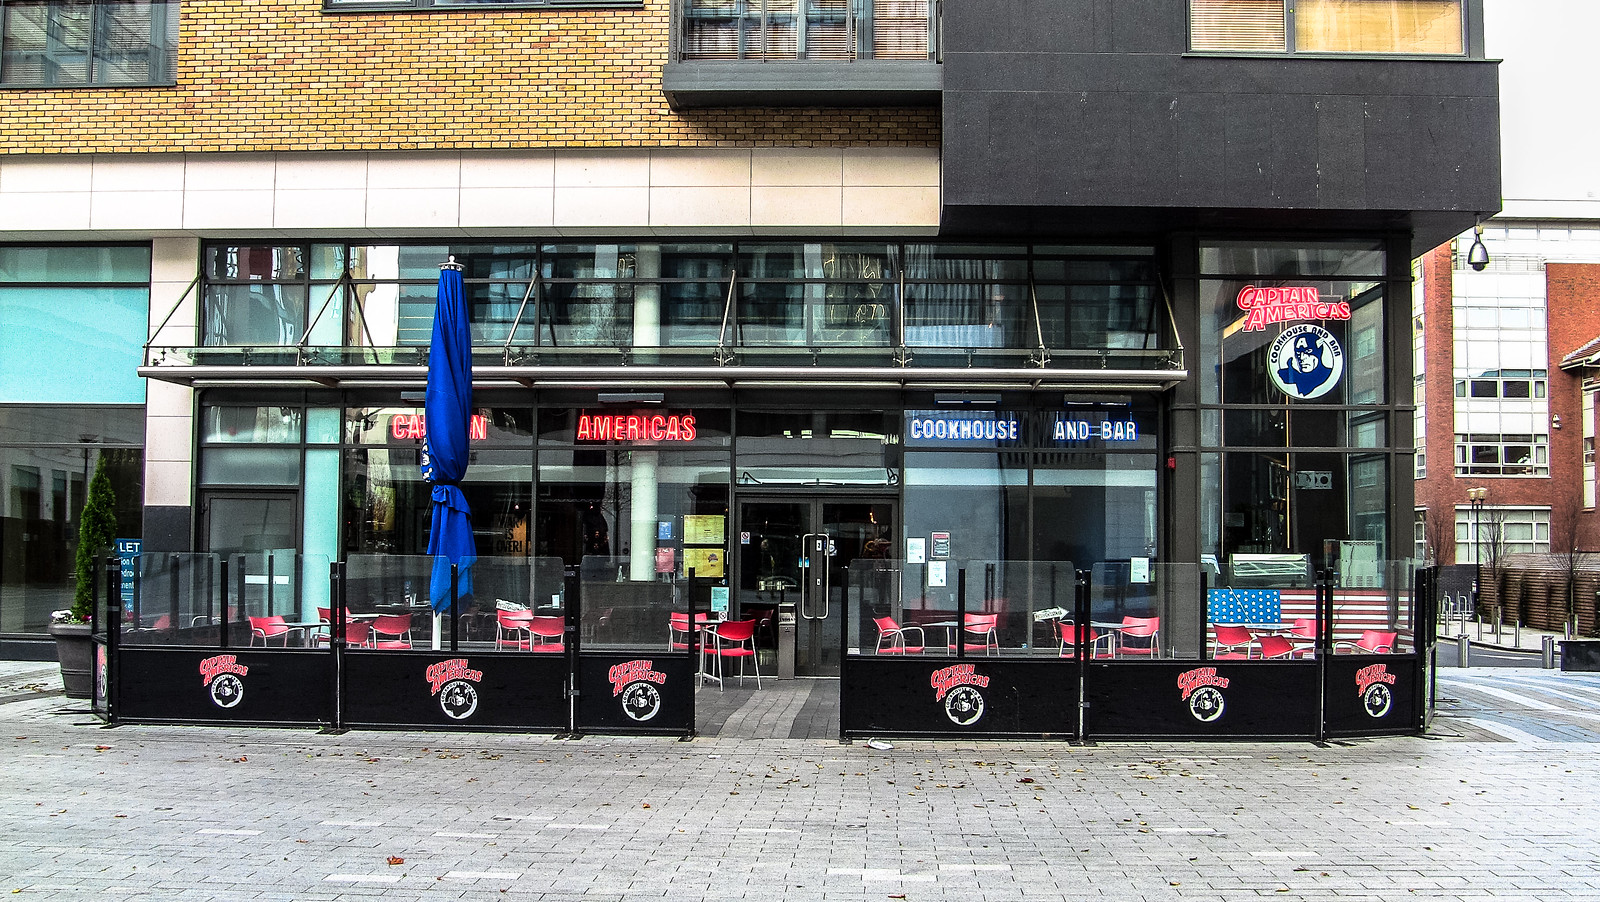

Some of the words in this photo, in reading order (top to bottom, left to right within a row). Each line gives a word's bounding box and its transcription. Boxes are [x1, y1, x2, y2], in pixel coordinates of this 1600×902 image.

[1237, 285, 1319, 310] CAPTAIN
[1242, 302, 1351, 332] AMERICAS
[1271, 326, 1308, 364] COOKHOUSE
[1312, 326, 1329, 339] AND
[1329, 340, 1341, 357] BAR
[577, 415, 696, 441] AMERICAS
[911, 419, 1017, 440] COOKHOUSE
[1053, 420, 1090, 440] AND
[1101, 420, 1138, 441] BAR
[120, 542, 140, 552] LET
[426, 659, 468, 683] CAPTAIN
[431, 668, 483, 696] AMERICAS
[609, 660, 652, 683] CAPTAIN
[613, 669, 666, 697] AMERICAS
[931, 664, 975, 688] CAPTAIN
[1177, 667, 1217, 689] CAPTAIN
[936, 674, 990, 702] AMERICAS
[1182, 676, 1229, 701] AMERICAS
